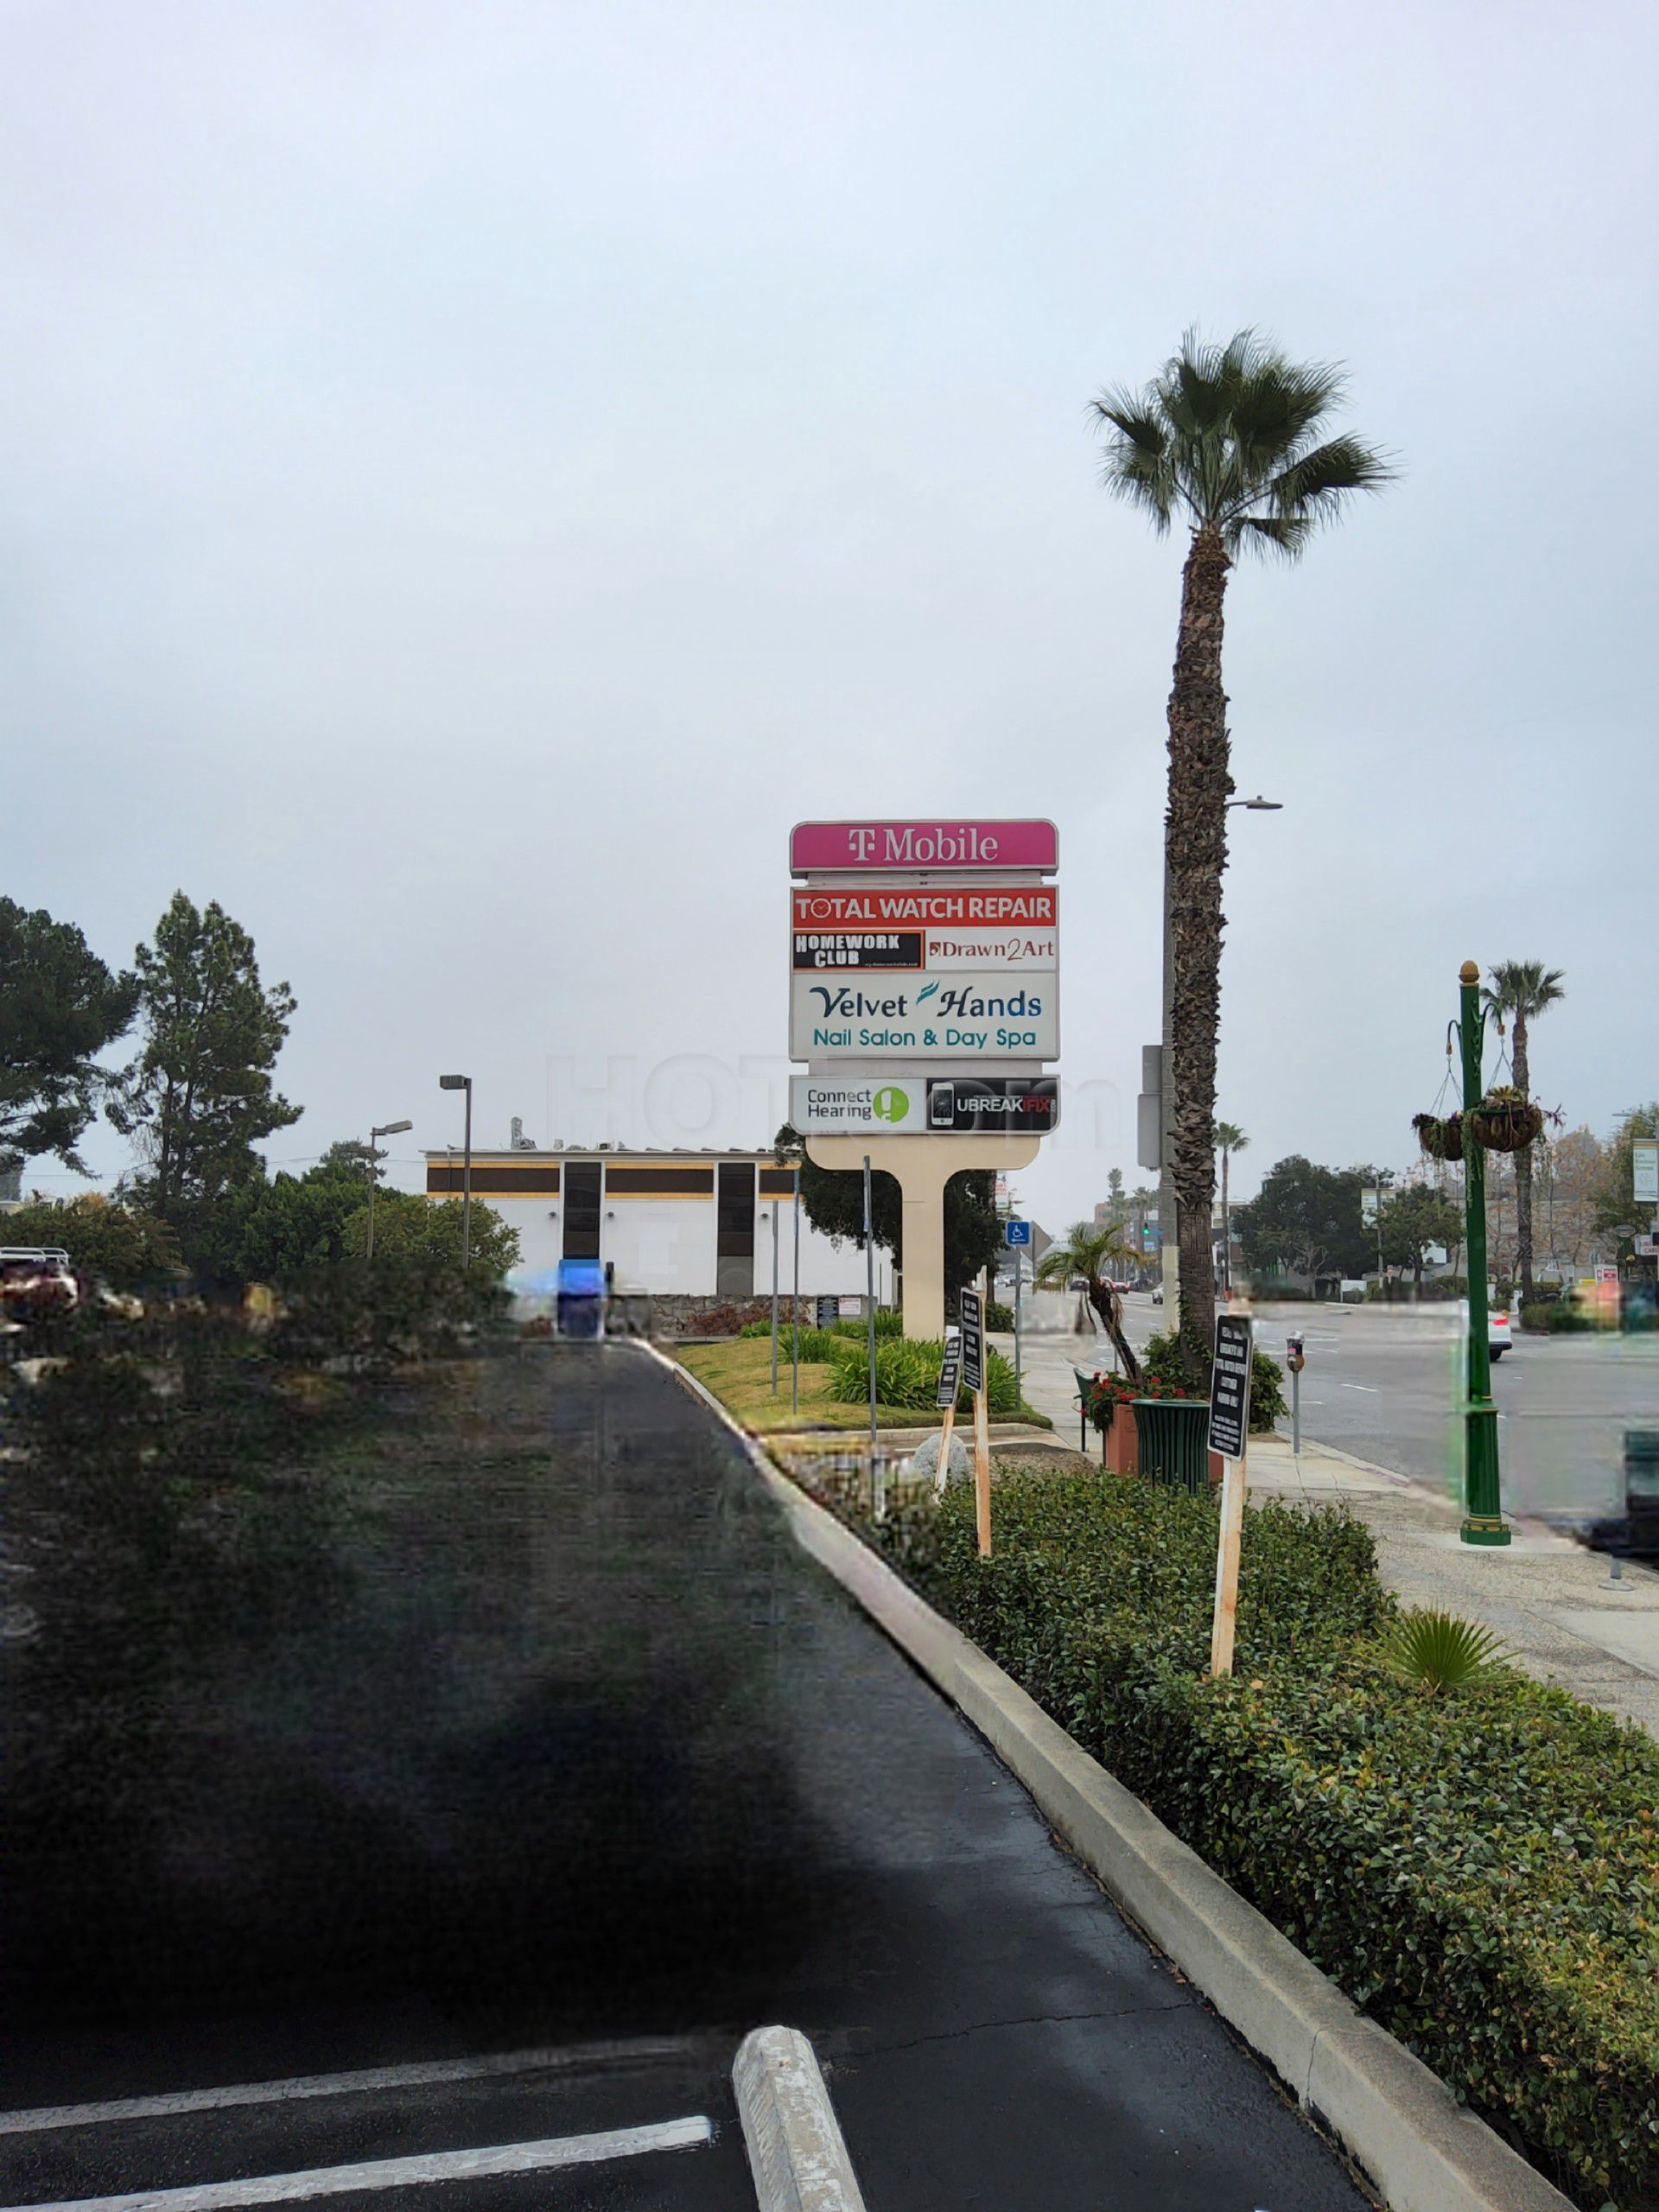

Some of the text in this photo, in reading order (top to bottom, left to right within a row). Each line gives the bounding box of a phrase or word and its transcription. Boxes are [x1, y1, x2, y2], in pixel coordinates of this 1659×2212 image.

[883, 827, 998, 861] Mobile
[795, 897, 1052, 918] TOTAL WATCH REPAIR
[796, 934, 899, 952] HOMEWORK
[943, 938, 1055, 961] Drawn2Art
[814, 950, 860, 967] CLUB
[809, 986, 1042, 1018] Velvet Hands
[814, 1027, 1036, 1050] Nail Salon & Day Spa
[807, 1089, 872, 1103] Connect
[807, 1104, 872, 1121] Hearing
